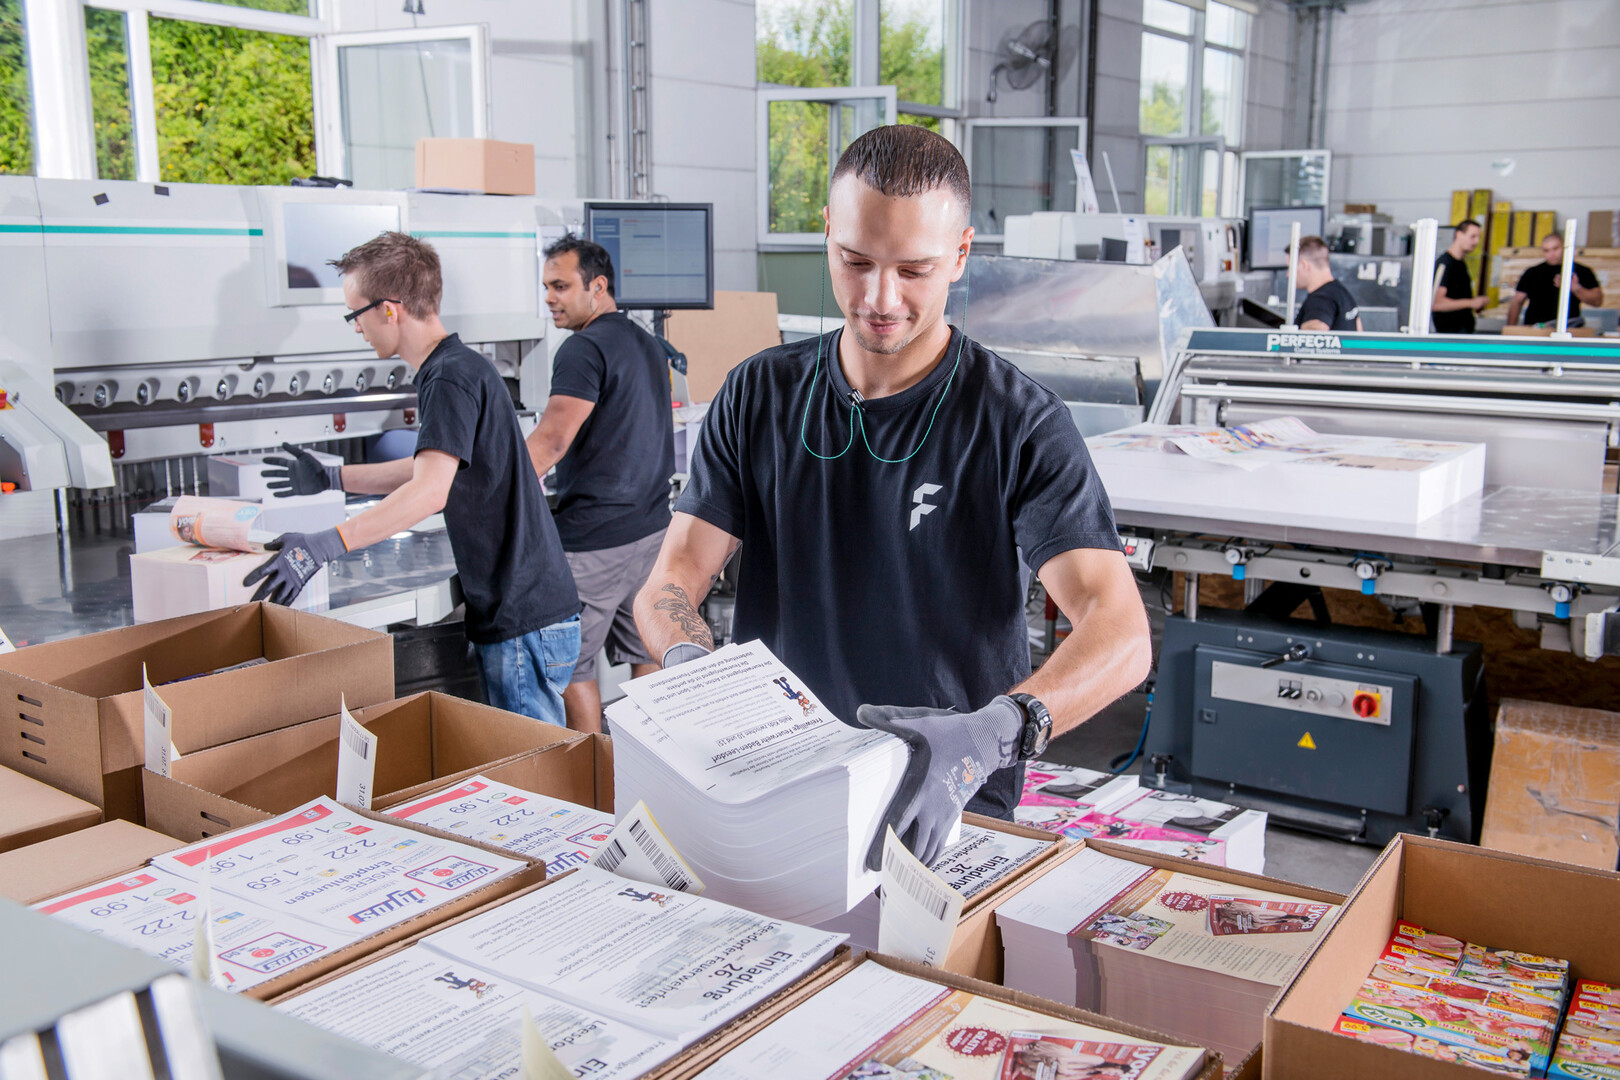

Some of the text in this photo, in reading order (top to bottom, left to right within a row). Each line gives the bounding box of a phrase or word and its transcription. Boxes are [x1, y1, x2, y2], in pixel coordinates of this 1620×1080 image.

[1266, 334, 1341, 351] PERFECTA
[710, 715, 823, 763] Freiwillige Feuerwehr Baden-Leesdorf
[446, 796, 492, 814] 1.99
[488, 808, 535, 826] 2.22
[277, 825, 333, 846] 1.99
[497, 826, 553, 850] Empfehl
[949, 834, 995, 859] Leesdorfer
[321, 838, 379, 860] 2.22
[242, 867, 302, 890] 1.59
[281, 859, 393, 905] Empfehlungen
[337, 864, 408, 892] UNSERE
[944, 863, 973, 876] 26.
[947, 855, 1011, 889] Einladung
[84, 892, 152, 918] 1.99
[129, 909, 201, 936] 2.22
[718, 921, 785, 957] Leesdorfer
[630, 955, 728, 1009] Feuerwehrfest
[699, 950, 795, 1002] Einladung
[704, 962, 746, 981] 26.
[545, 1019, 608, 1052] Leesdor
[958, 1030, 991, 1053] GRATIS
